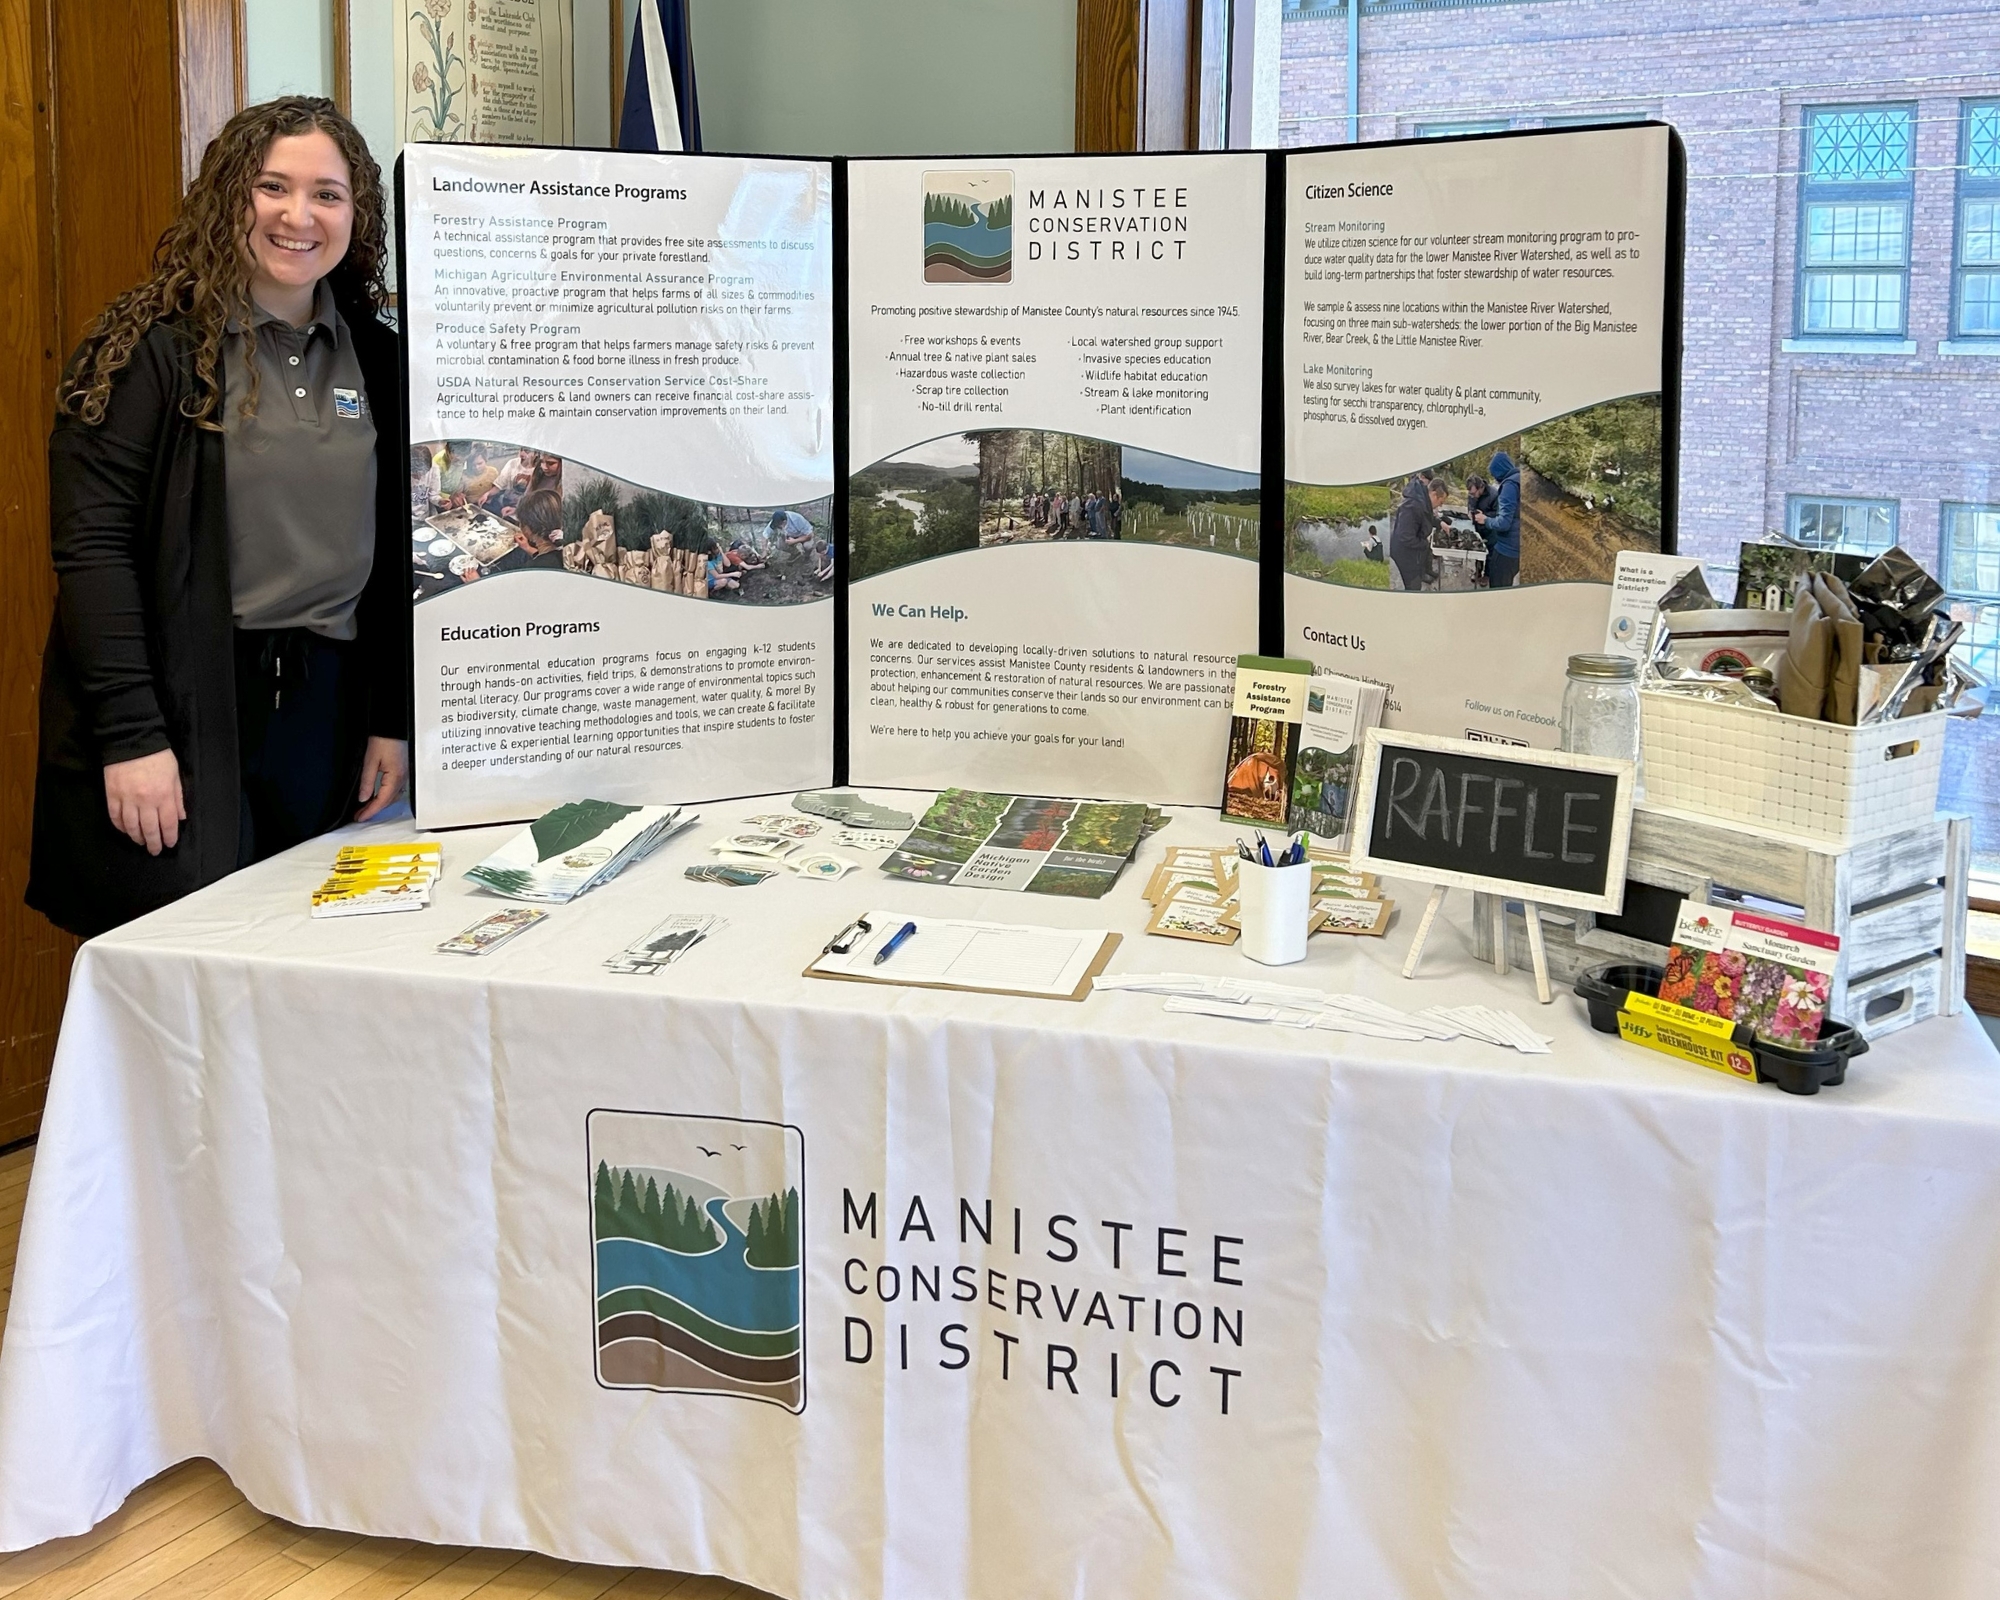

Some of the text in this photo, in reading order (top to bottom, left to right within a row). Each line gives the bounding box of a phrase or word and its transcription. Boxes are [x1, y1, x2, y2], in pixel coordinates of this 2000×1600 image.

[432, 177, 687, 202] Landowner Assistance Programs
[1305, 182, 1393, 199] Citizen Science
[1030, 188, 1188, 209] MANISTEE
[433, 213, 607, 231] Forestry Assistance Program
[1030, 216, 1188, 233] CONSERVATION
[1304, 220, 1385, 233] Stream Monitoring
[1030, 241, 1187, 260] DISTRICT
[434, 268, 754, 286] Michigan Agriculture Environmental Assurance Program
[870, 304, 916, 317] Promoting
[918, 306, 952, 317] positive
[954, 305, 1008, 317] stewardship
[1010, 305, 1020, 316] of
[1022, 306, 1062, 316] Manistee
[1064, 305, 1103, 318] County's
[1105, 306, 1139, 316] natural
[1141, 308, 1188, 316] resources
[1190, 308, 1215, 316] since
[435, 322, 580, 336] Produce Safety Program
[903, 334, 1020, 347] Free workshops & events
[1071, 336, 1222, 350] Local watershed group support
[888, 351, 1036, 364] Annual tree & native plant sales
[1082, 353, 1211, 366] Invasive species education
[899, 368, 1025, 379] Hazardous waste collection
[1084, 370, 1208, 381] Wildlife habitat education
[1303, 363, 1372, 379] Lake Monitoring
[436, 375, 768, 387] USDA Natural Resources Conservation Service Cost-Share
[915, 384, 1008, 396] Scrap tire collection
[1084, 386, 1208, 401] Stream & lake monitoring
[921, 401, 1002, 412] No-till drill rental
[1100, 403, 1191, 415] Plant identification
[1620, 566, 1638, 574] What
[1618, 575, 1666, 585] Conservation
[1617, 584, 1649, 592] District?
[871, 603, 968, 622] We Can Help.
[441, 621, 600, 641] Education Programs
[1303, 626, 1365, 651] Contact Us
[440, 641, 815, 676] Our environmental education programs focus on engaging k-12 students
[1252, 682, 1287, 694] Forestry
[1246, 692, 1291, 705] Assistance
[1326, 694, 1353, 705] MANISTEE
[1384, 698, 1402, 712] 9614
[1250, 704, 1285, 716] Program
[1325, 706, 1352, 716] DISTRICT
[1464, 699, 1492, 713] Follow
[1492, 707, 1502, 715] us
[1503, 709, 1515, 718] on
[1516, 709, 1557, 727] Facebook
[869, 724, 1124, 748] We're here to help you achieve your goals for your land!
[1385, 757, 1600, 864] RAFFLE
[974, 859, 1012, 869] Native
[979, 853, 1031, 864] Michigan
[964, 871, 1005, 881] Design
[970, 866, 1011, 875] Garden
[1735, 920, 1788, 938] BUTTERFLY GARDEN
[1764, 938, 1800, 953] Monarch
[1742, 941, 1816, 966] Sanctuary Garden
[1621, 1021, 1653, 1039] Jiffy
[1656, 1032, 1709, 1057] GREENHOUSE
[1710, 1049, 1724, 1062] KIT
[1731, 1055, 1742, 1069] 12
[843, 1188, 1244, 1287] MANISTEE
[844, 1258, 1243, 1347] CONSERVATION
[844, 1316, 1242, 1416] DISTRICT
